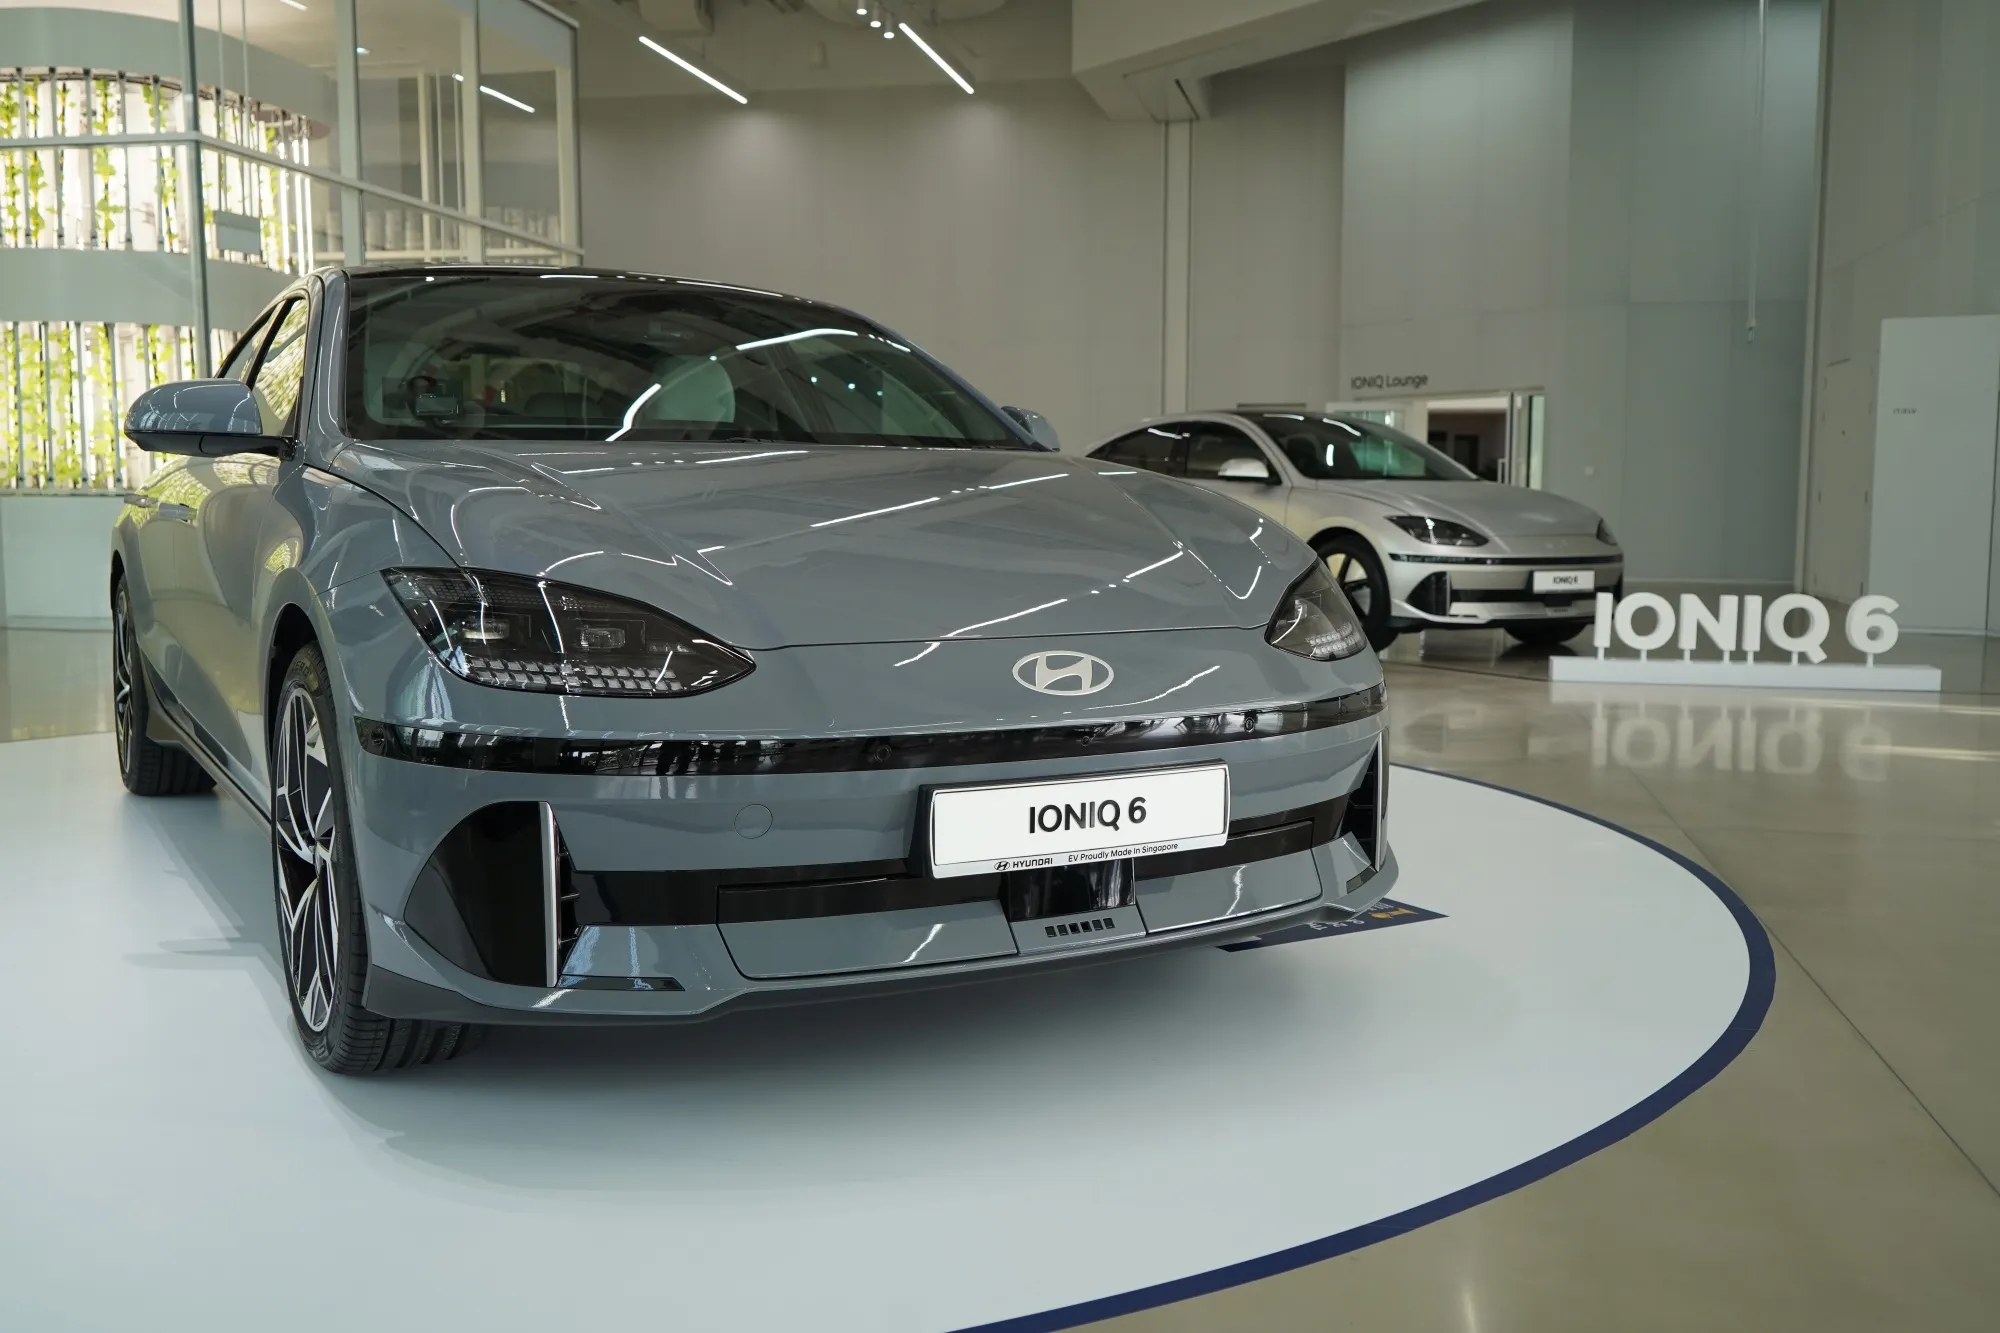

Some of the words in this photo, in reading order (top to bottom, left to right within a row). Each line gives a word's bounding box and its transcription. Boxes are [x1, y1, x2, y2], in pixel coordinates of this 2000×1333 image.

[1350, 374, 1385, 390] IONIQ
[1386, 374, 1428, 389] Lounge
[1594, 592, 1830, 664] IONIQ
[1846, 594, 1900, 655] 6
[1029, 799, 1121, 834] IONIQ
[1127, 796, 1147, 824] 6
[1012, 857, 1053, 869] HYUNDAI
[1068, 854, 1079, 863] EV
[1080, 850, 1110, 861] Proudly
[1110, 848, 1133, 858] Made
[1133, 847, 1141, 855] In
[1141, 842, 1180, 854] Singapore
